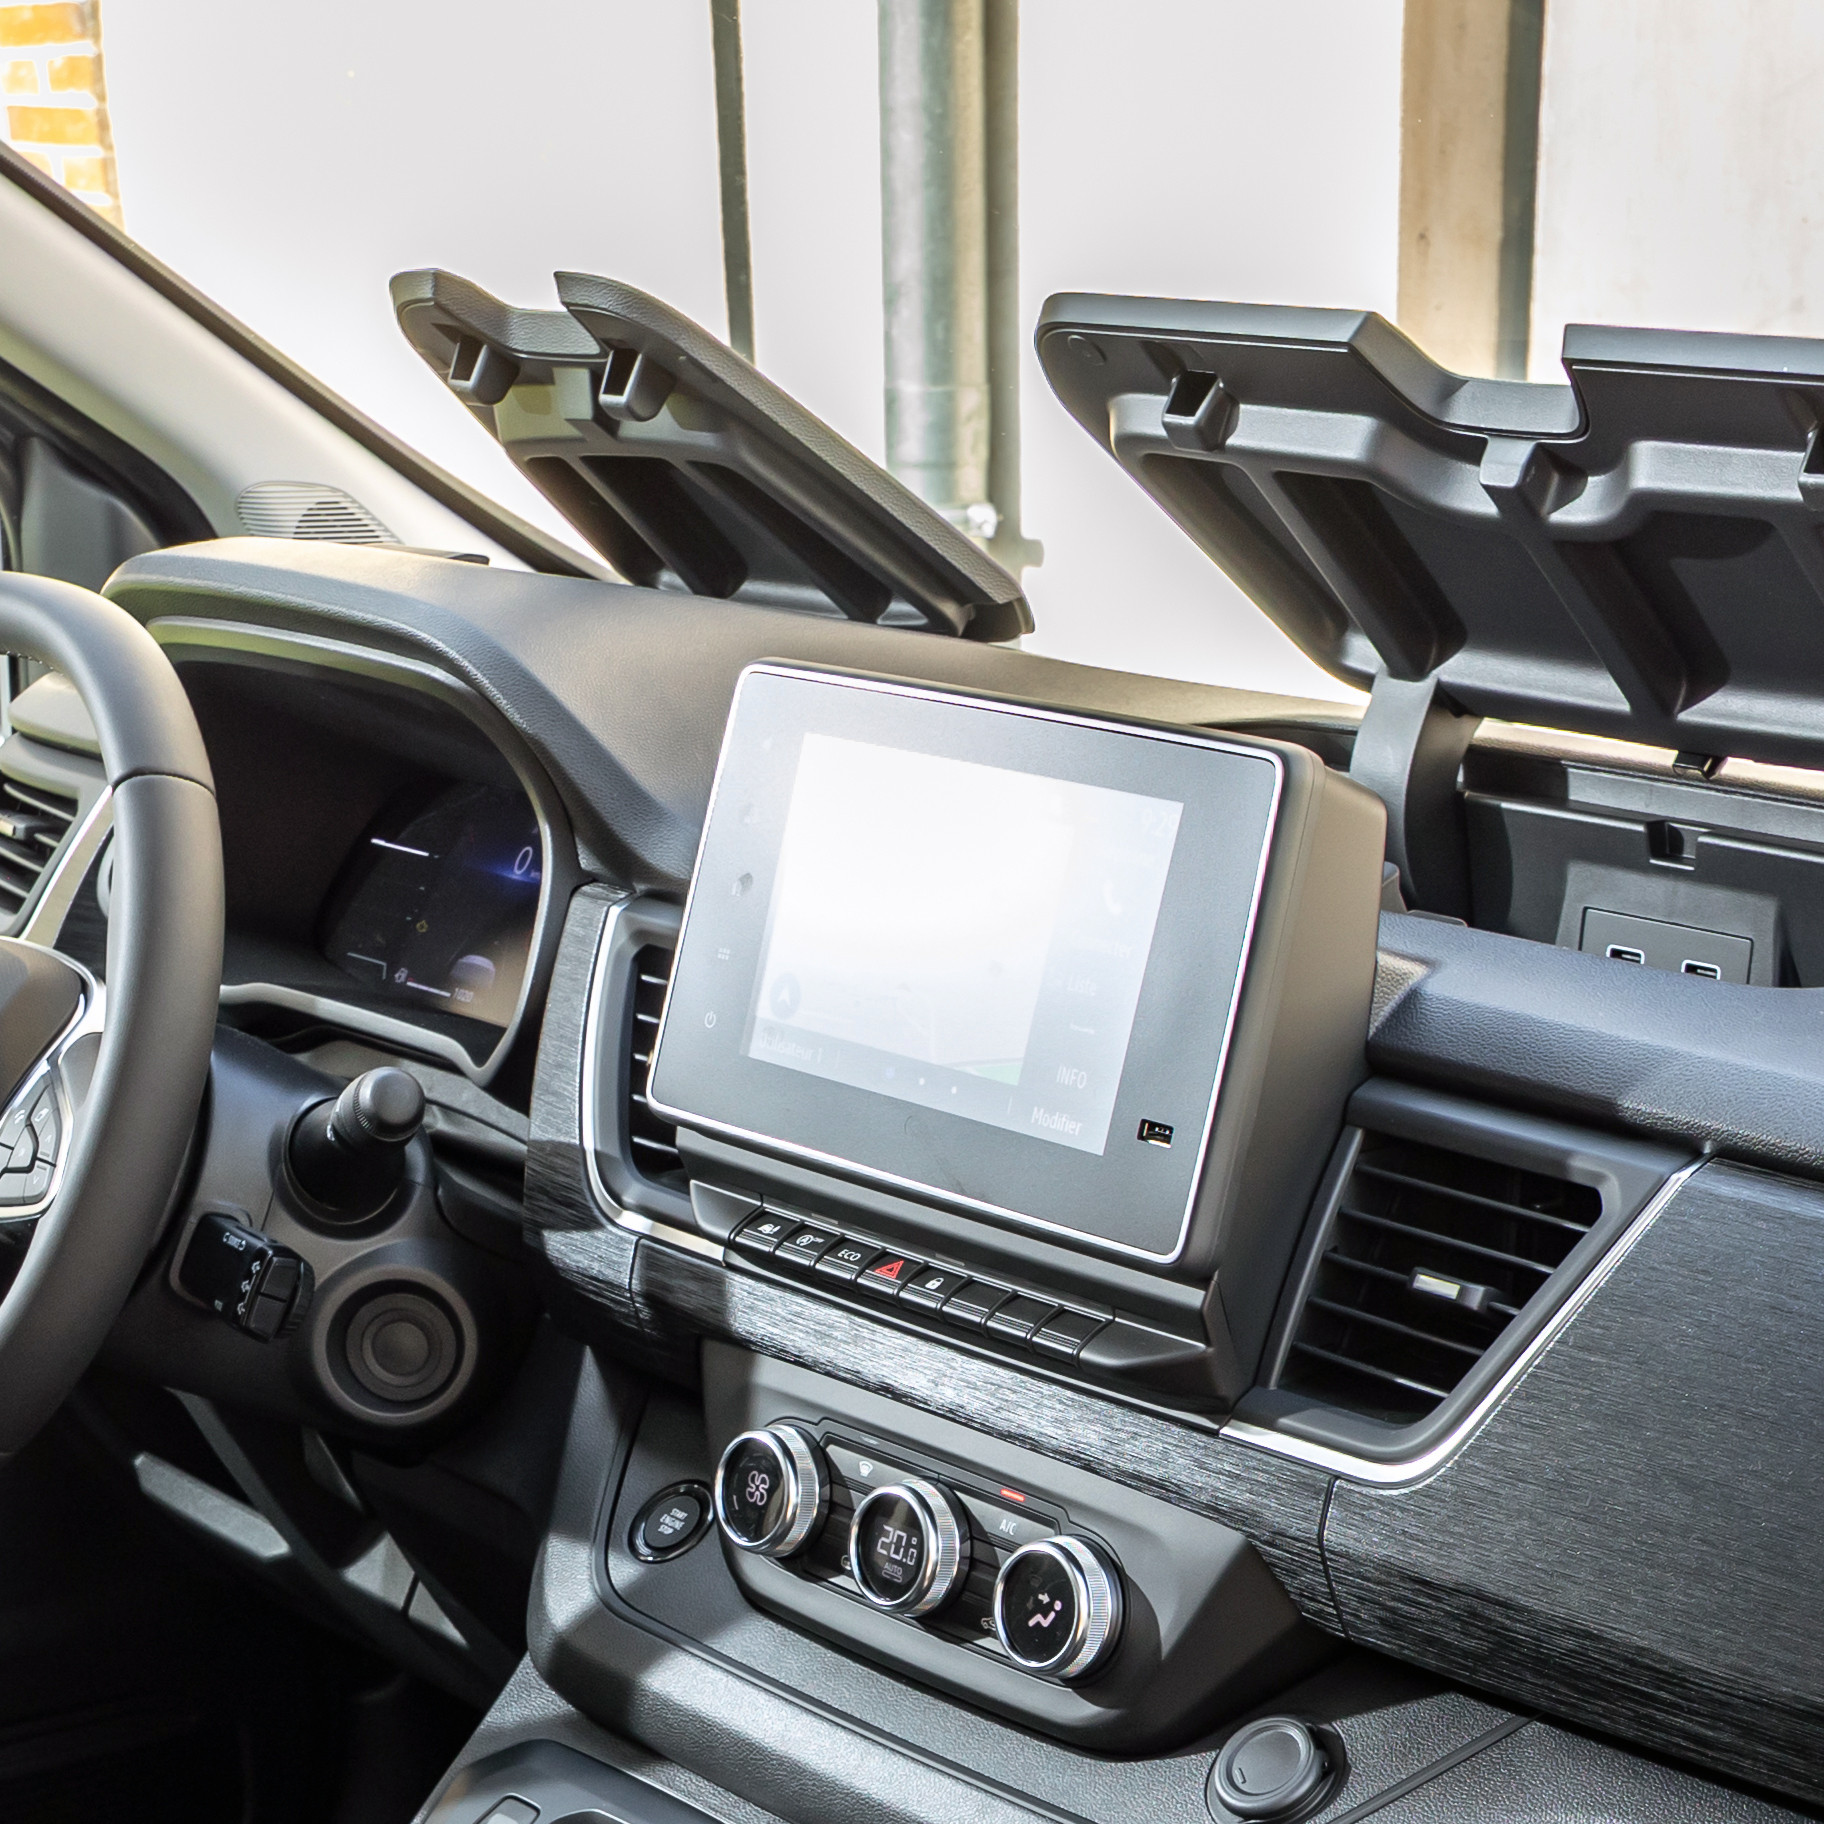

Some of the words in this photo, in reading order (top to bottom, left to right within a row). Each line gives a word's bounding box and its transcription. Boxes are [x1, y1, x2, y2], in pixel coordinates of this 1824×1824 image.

[1056, 1065, 1088, 1089] INFO
[1031, 1106, 1083, 1136] Modifier
[837, 1249, 862, 1262] ECO
[999, 1519, 1017, 1536] A/C
[884, 1562, 902, 1576] AUTO
